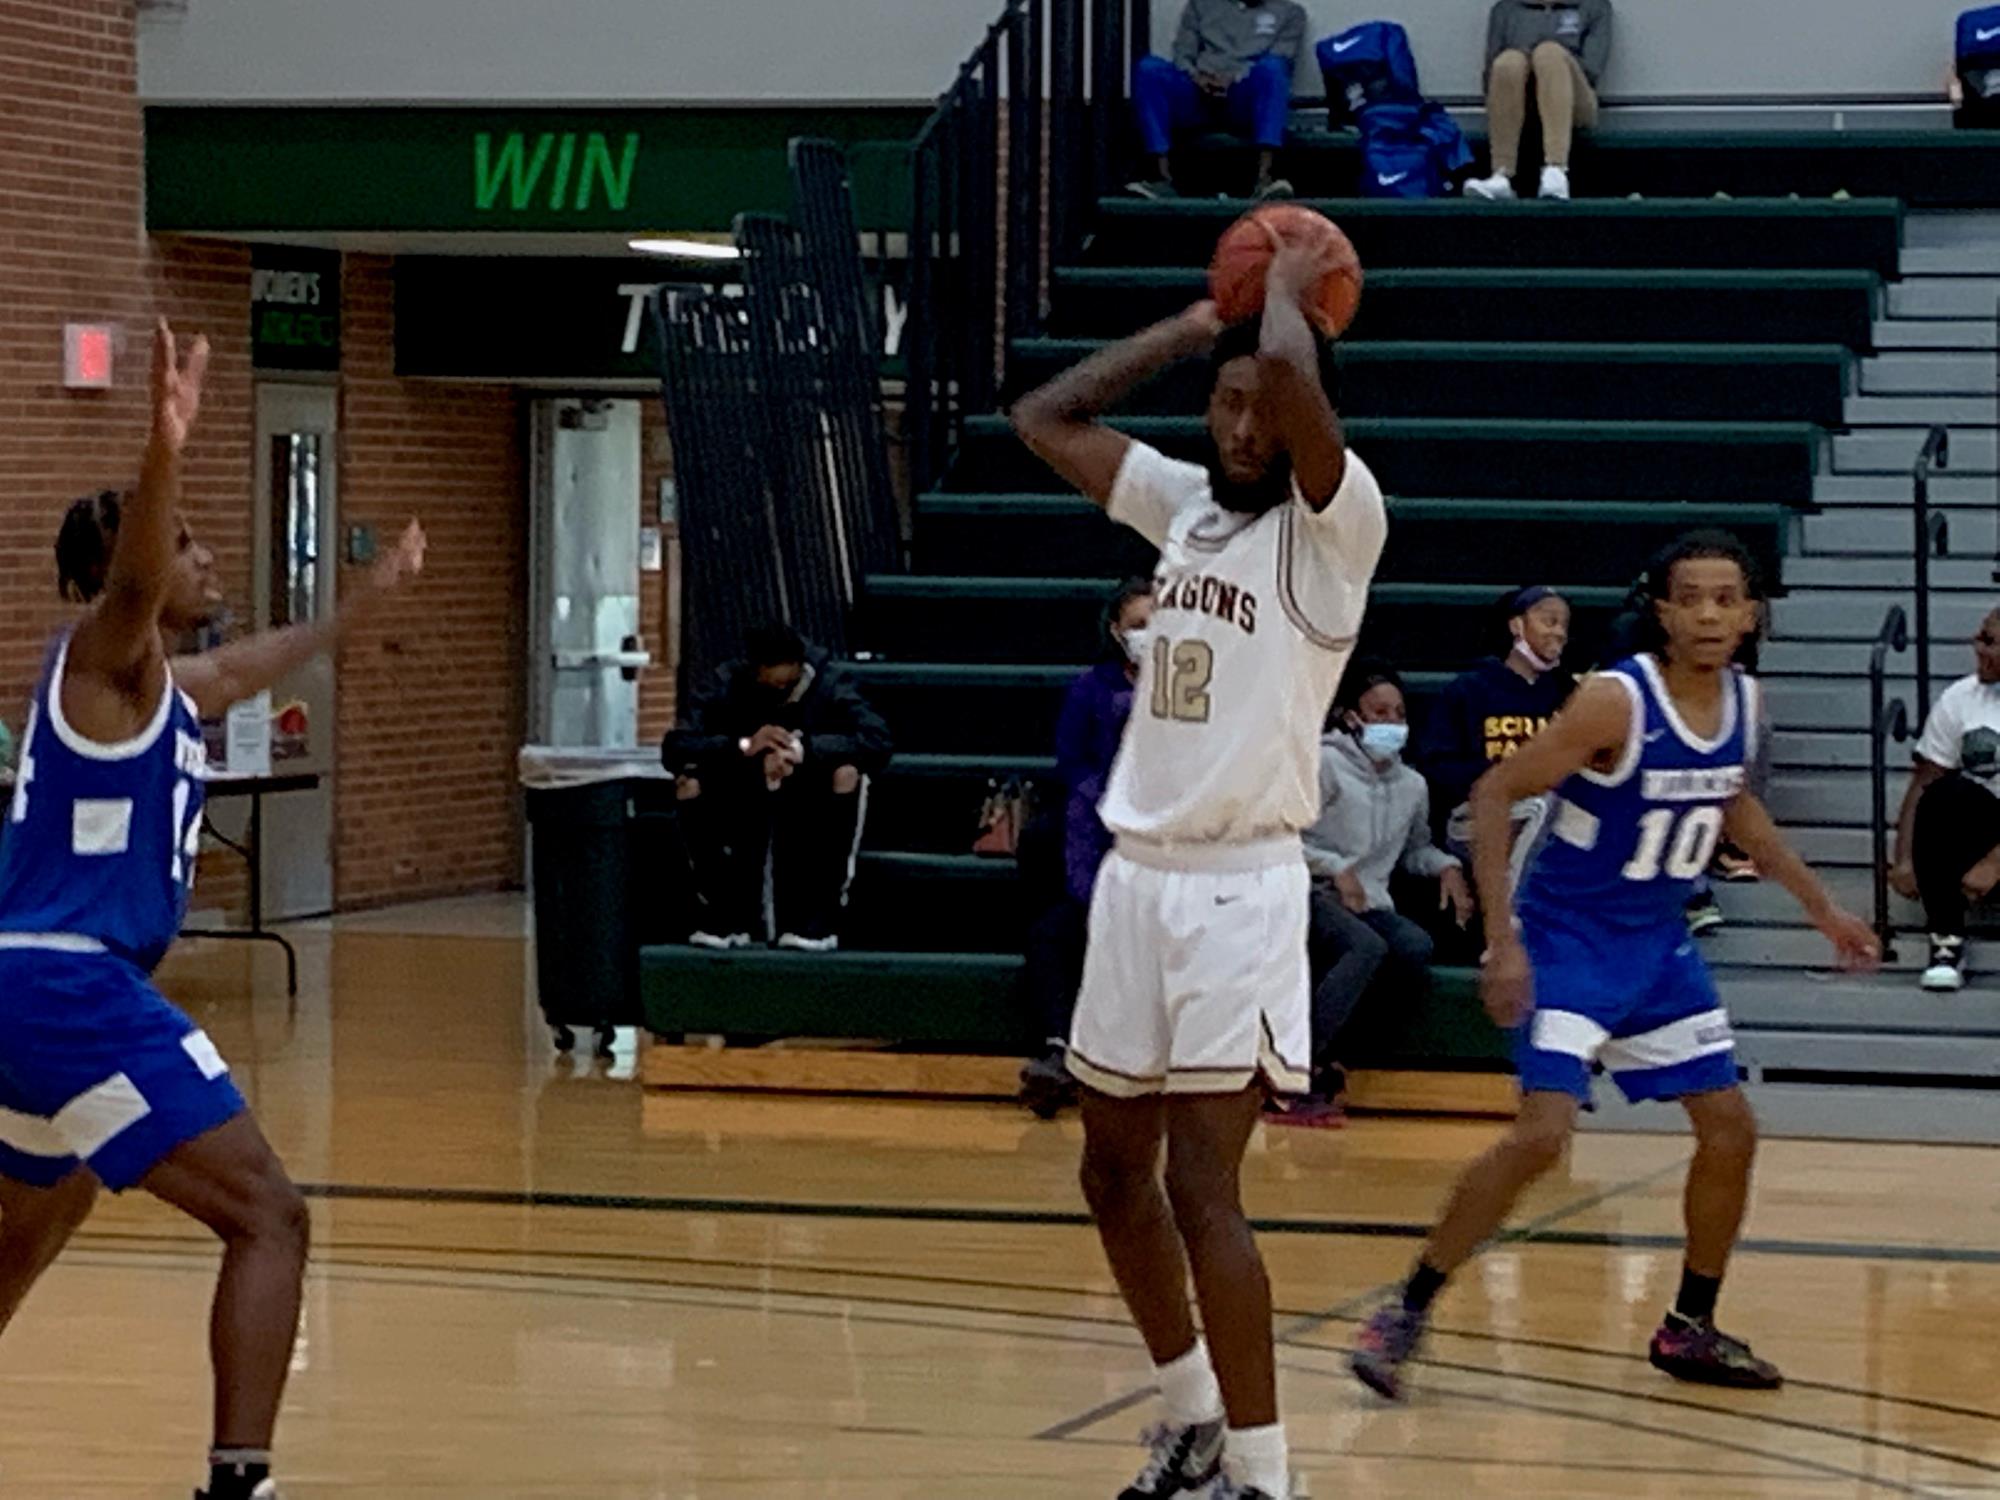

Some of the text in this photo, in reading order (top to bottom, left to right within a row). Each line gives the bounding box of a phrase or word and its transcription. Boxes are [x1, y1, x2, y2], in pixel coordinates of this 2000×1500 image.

[472, 131, 640, 212] WIN
[1154, 574, 1257, 635] AGONS
[1150, 634, 1213, 723] 12
[1621, 805, 1724, 880] 10
